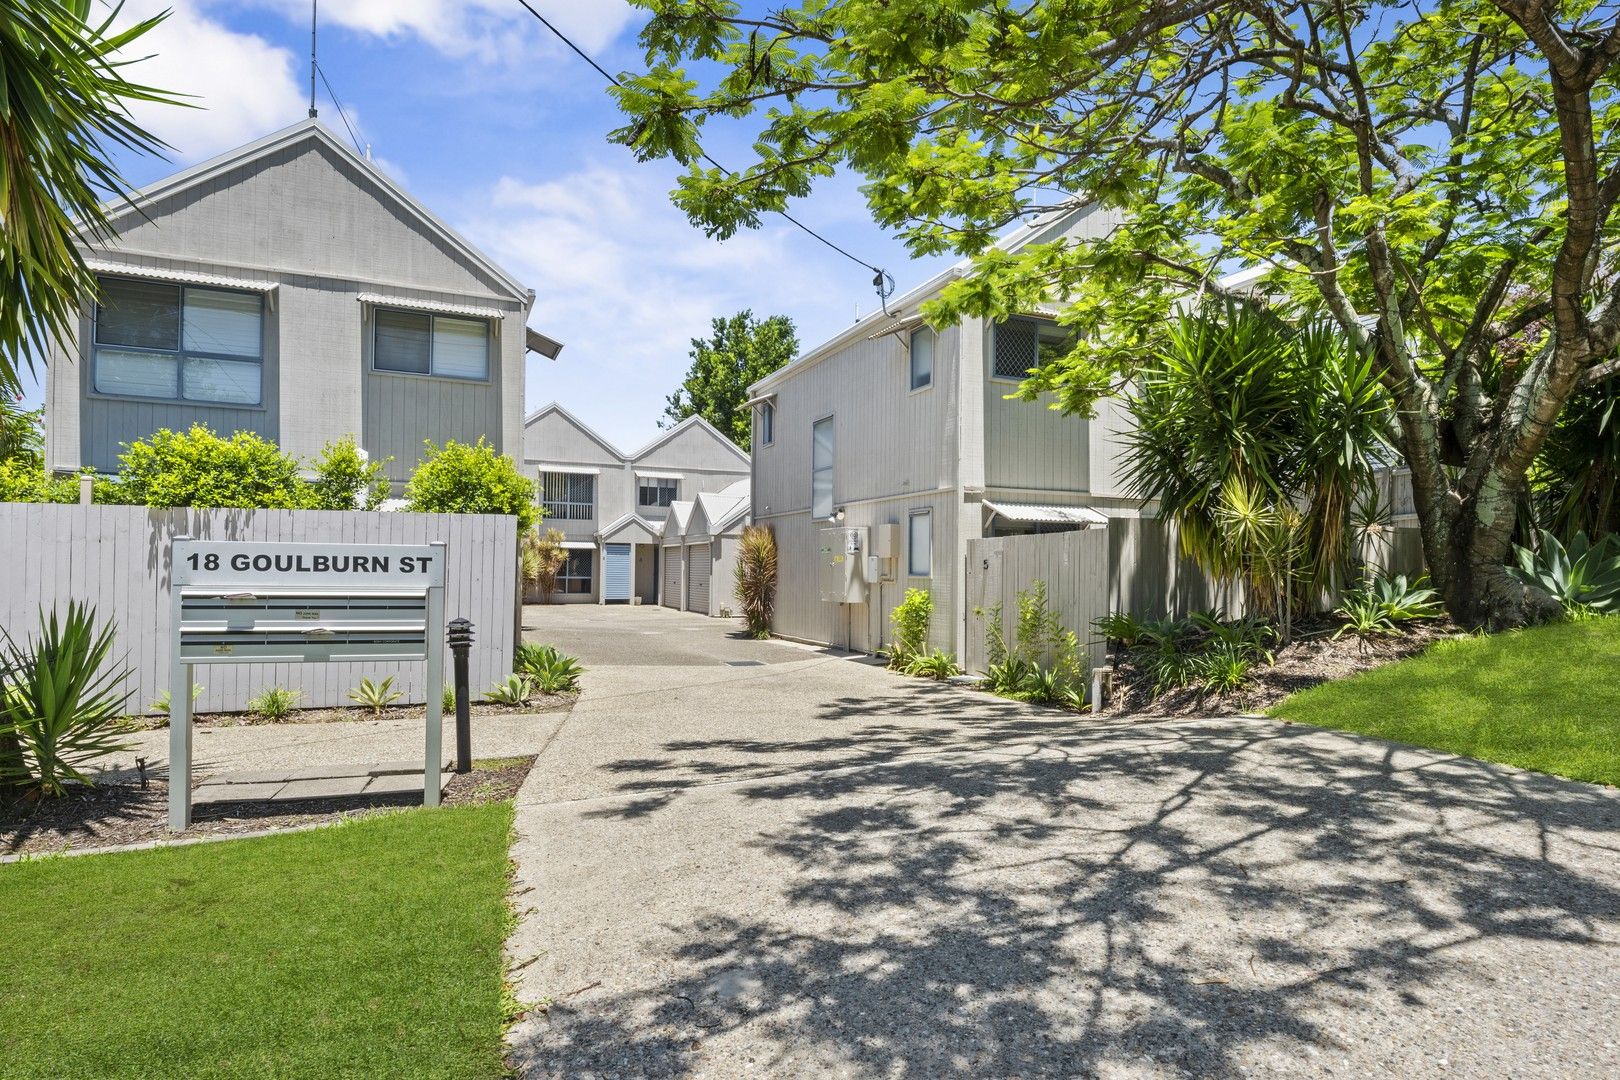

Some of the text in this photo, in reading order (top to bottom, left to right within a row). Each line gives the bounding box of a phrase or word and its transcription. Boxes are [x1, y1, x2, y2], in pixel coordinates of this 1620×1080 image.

[187, 552, 433, 573] 18 GOULBURN ST
[983, 559, 989, 570] 5
